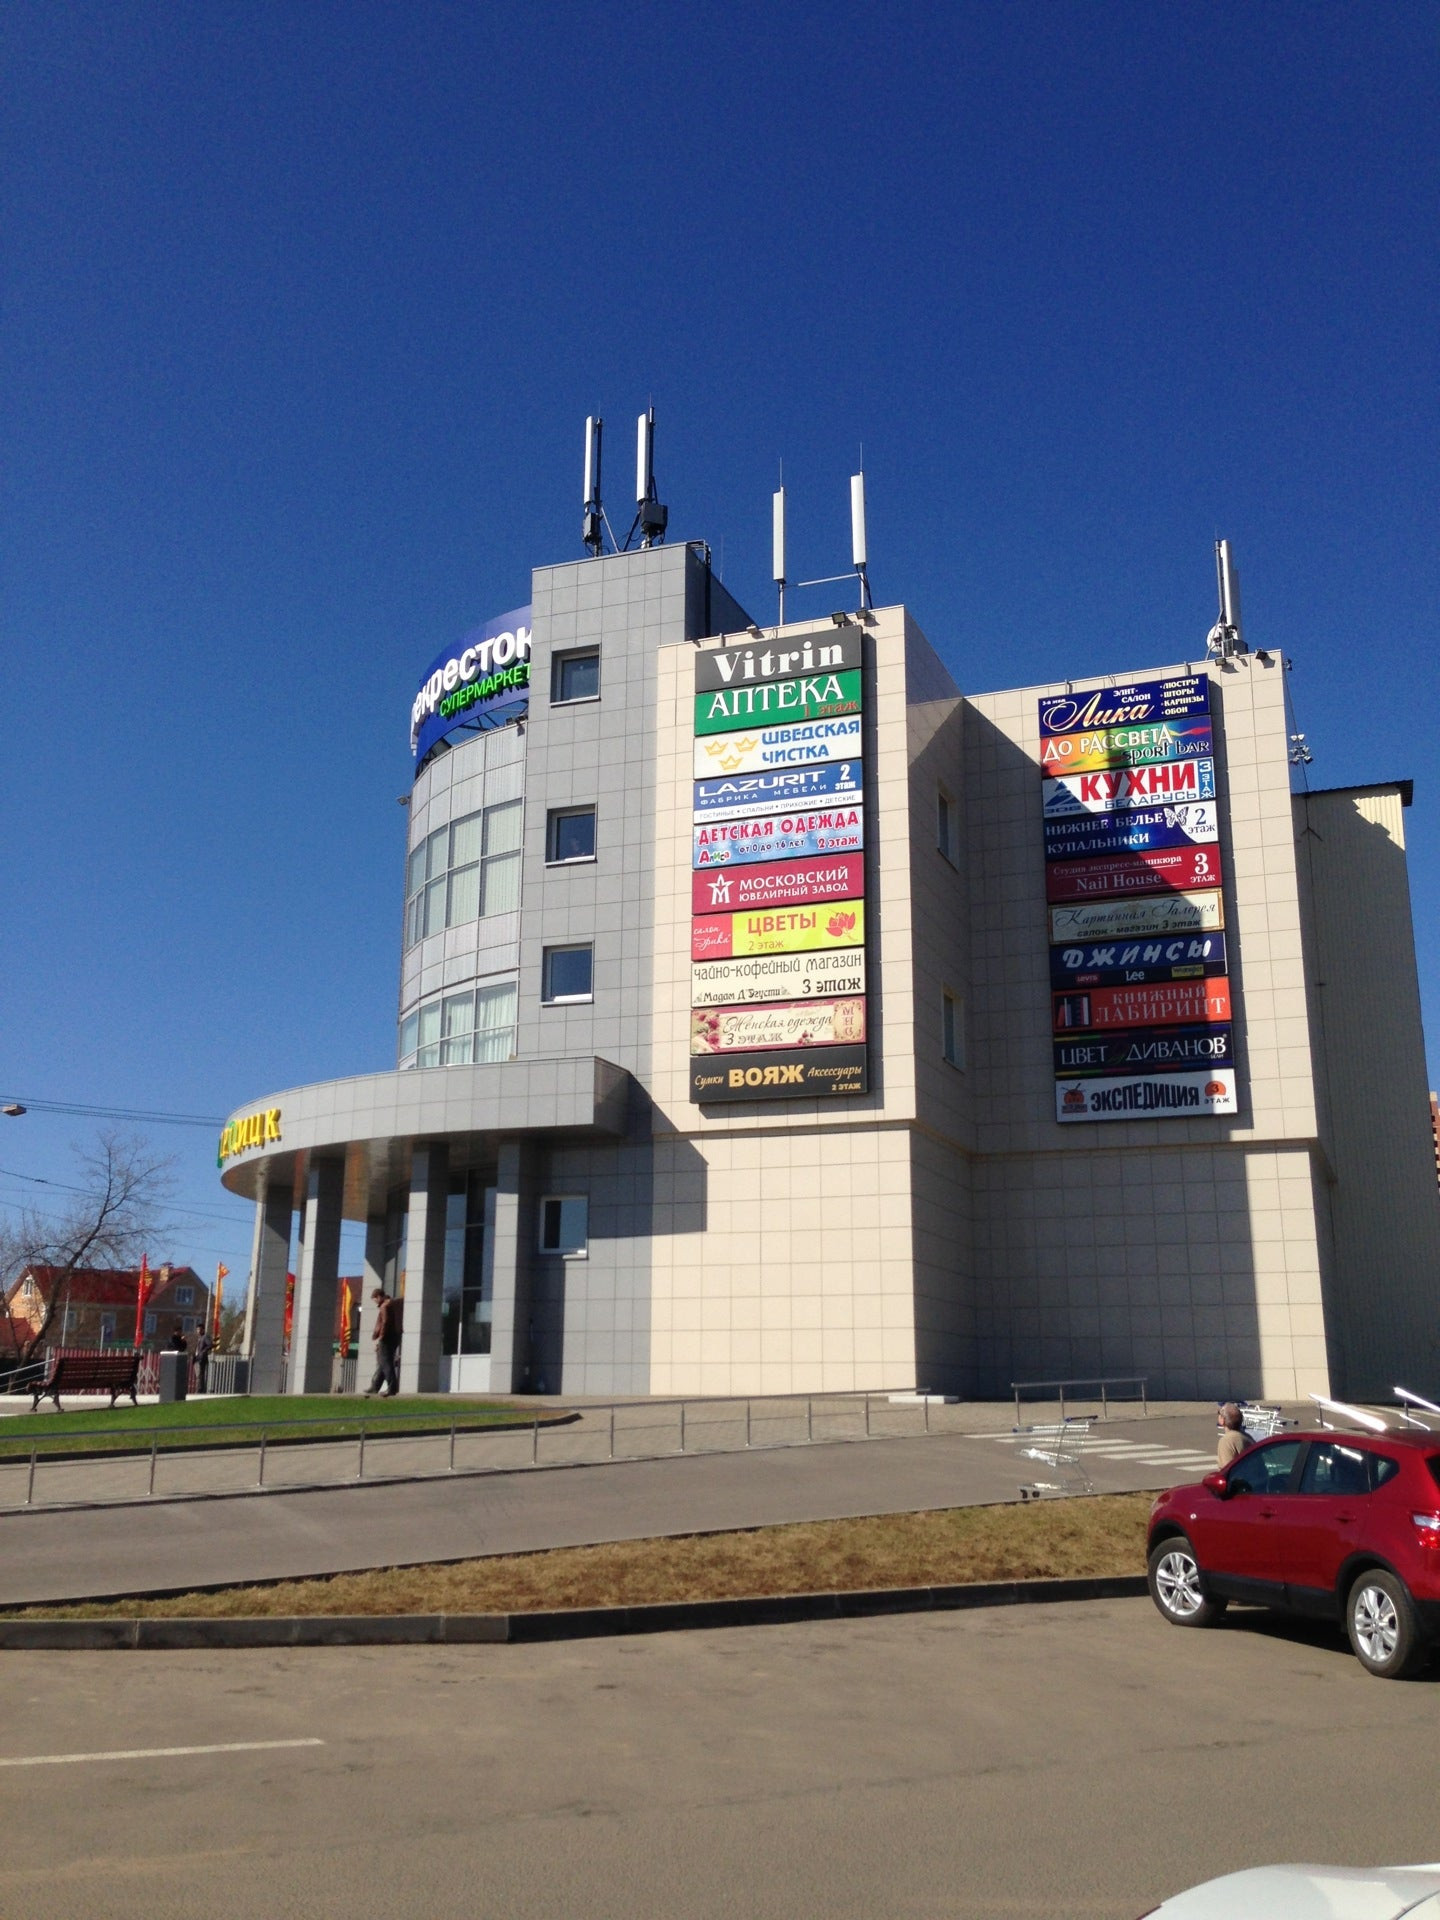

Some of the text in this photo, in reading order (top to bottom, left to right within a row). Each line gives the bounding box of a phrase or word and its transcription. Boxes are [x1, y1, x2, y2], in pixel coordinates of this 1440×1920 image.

[713, 641, 844, 682] Vitrin
[439, 662, 531, 717] СУПЕРМАРКЕТ
[707, 675, 844, 719] АПТЕКА
[1121, 694, 1151, 703] САЛОН
[1163, 688, 1194, 698] ШТОРЫ
[818, 701, 859, 716] этаж
[1164, 695, 1204, 707] КАРНИЗЫ
[1164, 706, 1188, 715] ОБОИ
[1043, 692, 1154, 731] Лика
[762, 720, 860, 745] ШВЕДСКАЯ
[1043, 723, 1173, 763] ДО РАССВЕТА
[762, 744, 830, 763] ЧИСТКА
[840, 764, 851, 781] 2
[1199, 761, 1211, 772] 3
[699, 770, 826, 797] LAZURIT
[1080, 762, 1195, 802] КУХНИ
[1200, 773, 1213, 799] ЭТАЖ
[700, 784, 827, 805] ФАБРИКА МЕБЕЛИ
[742, 805, 774, 814] СПАЛЬНИ
[780, 800, 818, 809] ПРИХОЖИЕ
[824, 795, 856, 804] ДЕТСКИЕ
[1105, 791, 1197, 809] БЕЛАРУСЬ
[1046, 812, 1163, 836] НИЖНЕЕ БЕЛЬЕ
[1194, 808, 1206, 825] 2
[698, 811, 858, 845] ДЕТСКАЯ ОДЕЖДА
[1188, 824, 1216, 834] этаж
[740, 839, 805, 853] от 0 до 16 лет
[817, 836, 858, 849] 2 этаж
[1047, 832, 1149, 854] КУПАЛЬНИКИ
[698, 850, 730, 864] Алиса
[1194, 853, 1209, 875] 3
[739, 866, 848, 891] МОСКОВСКИЙ
[1076, 873, 1161, 891] Nail House
[739, 882, 848, 902] ЮВЕЛИРНЫЙ ЗАВОД
[748, 912, 816, 936] ЦВЕТЫ
[1055, 908, 1146, 927] Картинная
[1162, 920, 1169, 929] 3
[1172, 919, 1201, 929] этаж
[748, 940, 784, 951] 2 этаж
[1063, 939, 1211, 968] ДЖИНСЫ
[694, 958, 800, 980] чайно-кофейный
[1126, 970, 1145, 981] Lee
[802, 977, 861, 994] 3 этаж
[1113, 985, 1205, 1005] КНИЖНЫЙ
[703, 991, 735, 1004] Мадам
[1096, 997, 1226, 1022] ЛАБИРИНТ
[722, 1013, 785, 1034] Женская
[787, 1015, 832, 1034] одежда
[726, 1032, 734, 1045] 3
[1061, 1046, 1108, 1065] ЦВЕТ
[1126, 1036, 1226, 1061] ДИВАНОВ
[694, 1064, 862, 1090] Сумки ВОЯЖ Аксессуары
[1091, 1081, 1199, 1112] ЭКСПЕДИЦИЯ
[1211, 1083, 1219, 1093] 3
